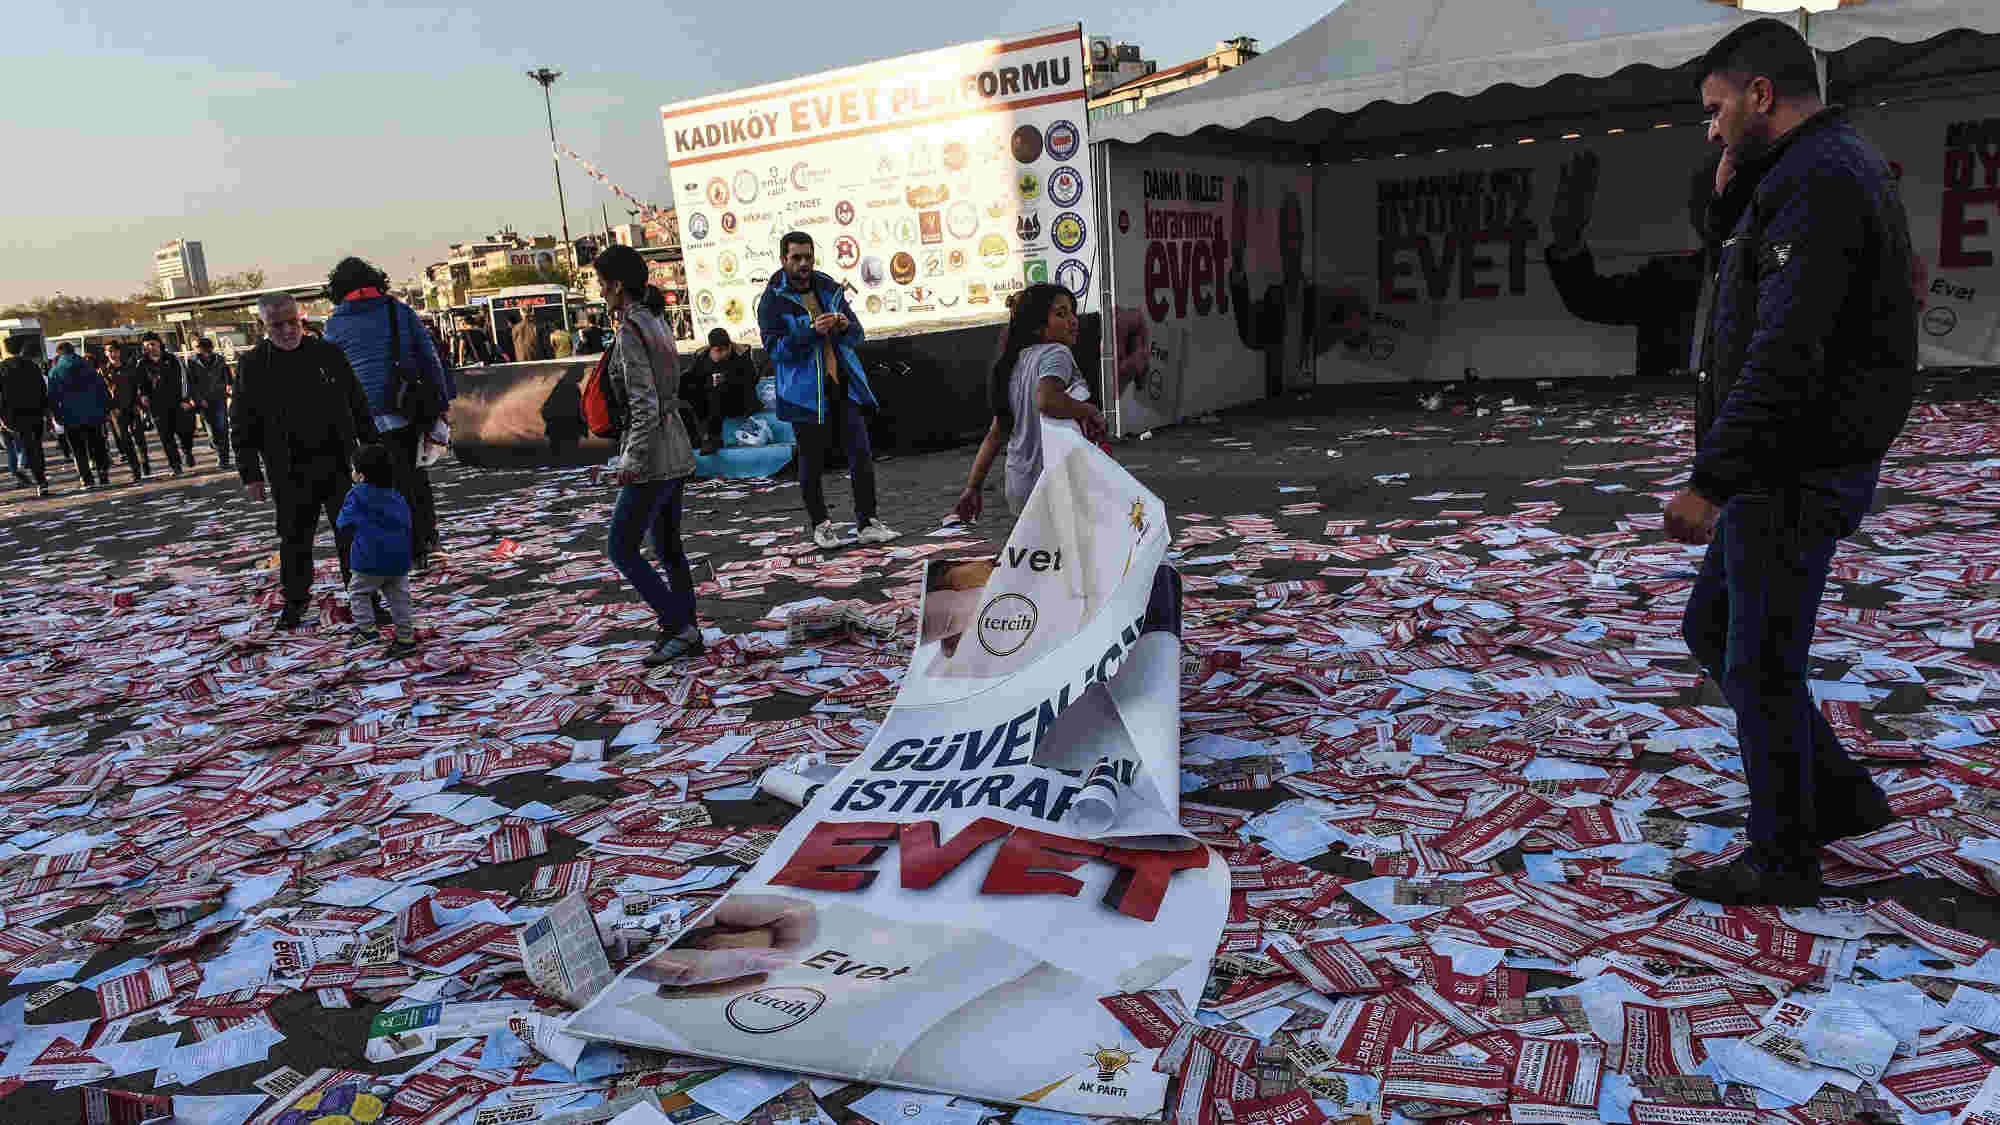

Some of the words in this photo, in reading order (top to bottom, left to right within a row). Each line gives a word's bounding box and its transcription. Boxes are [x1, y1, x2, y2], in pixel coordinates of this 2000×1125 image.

[674, 109, 778, 153] KADIKÖY
[790, 83, 882, 133] EVET
[1145, 241, 1231, 322] evet
[1378, 230, 1538, 304] EVET
[993, 544, 1062, 572] vet
[984, 614, 1032, 632] tercih
[767, 816, 1209, 922] EVET
[800, 949, 911, 981] Evet
[1079, 1080, 1094, 1093] AK
